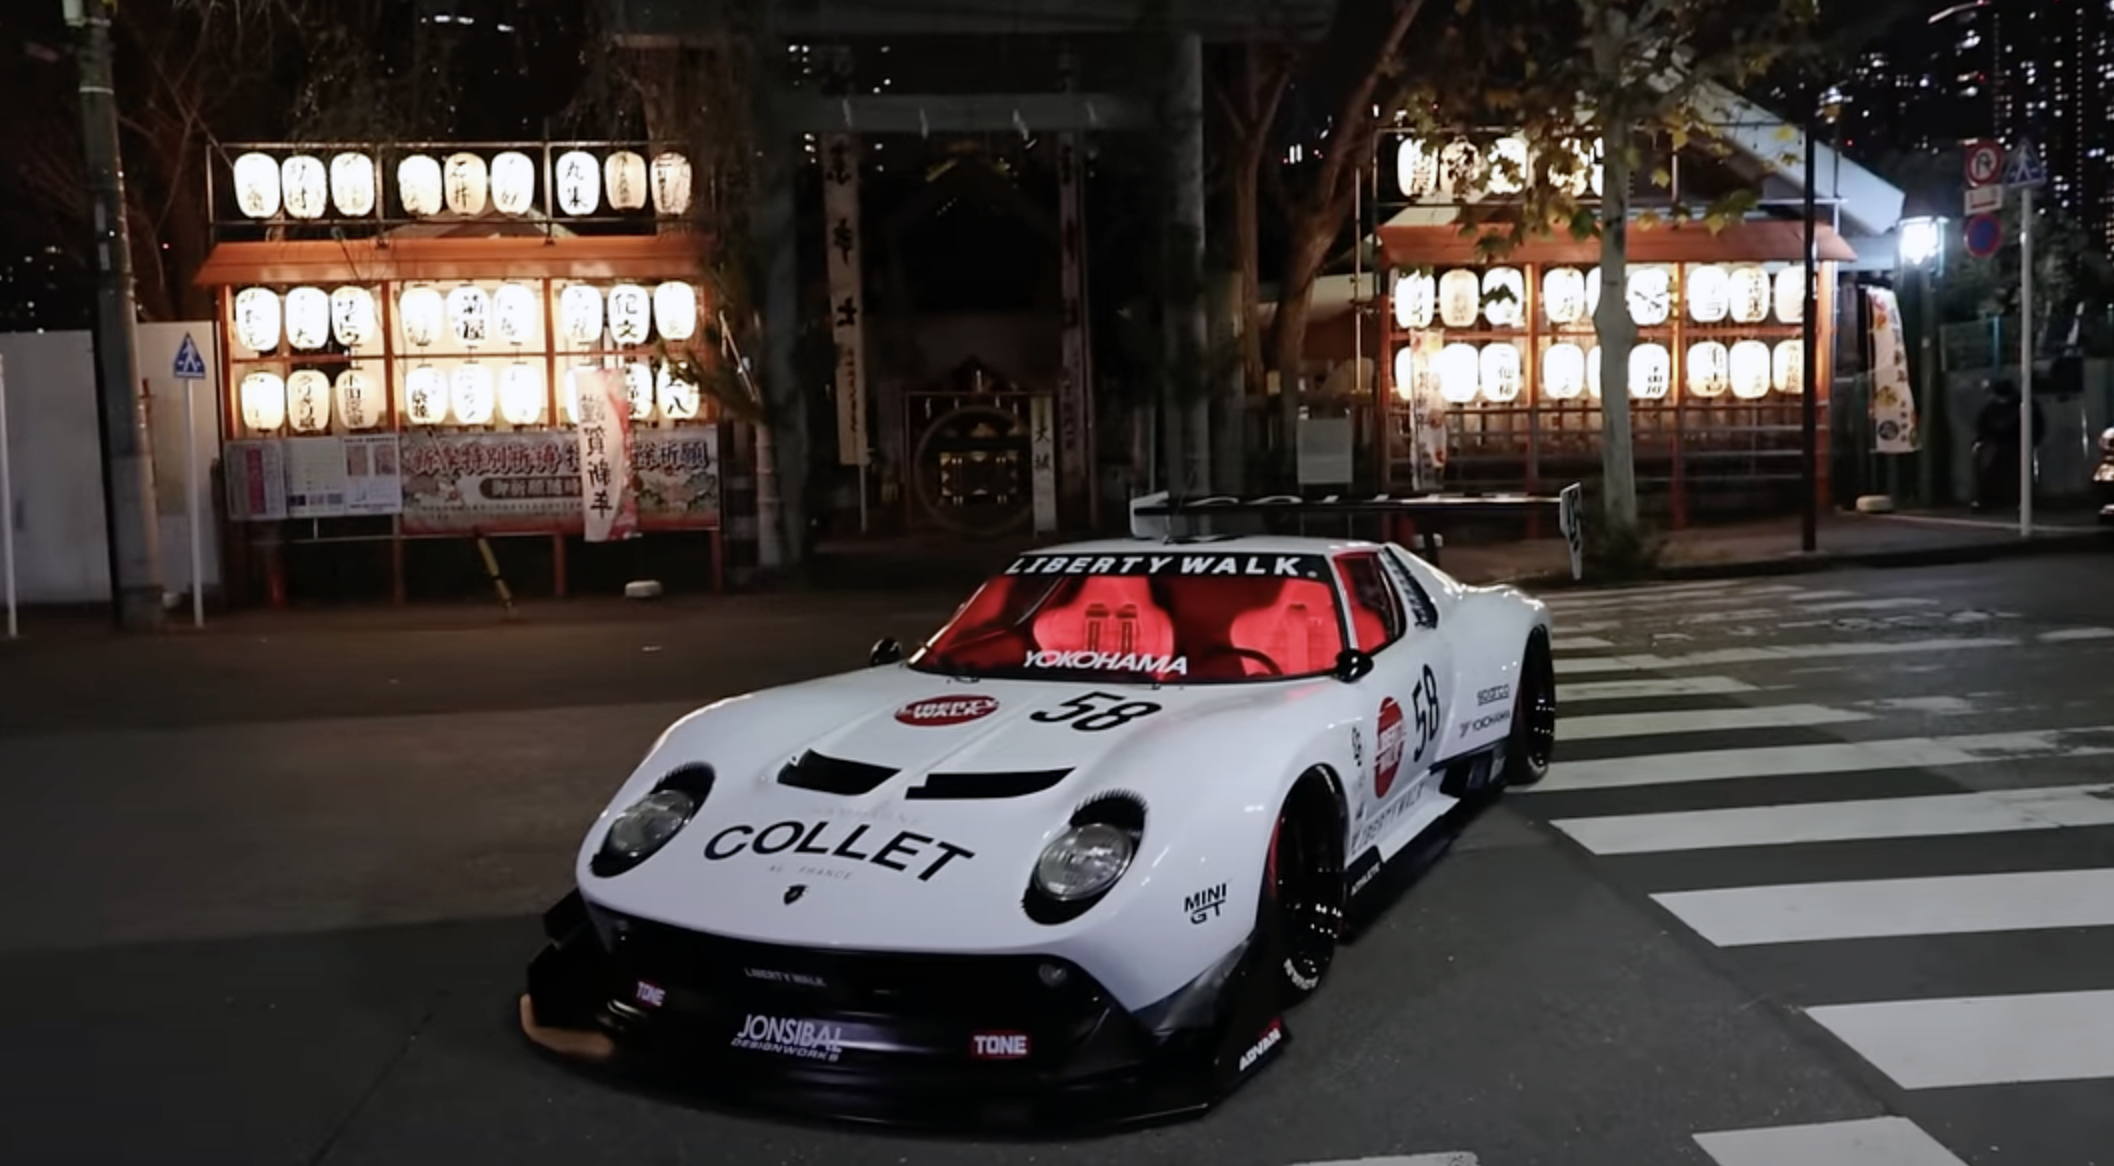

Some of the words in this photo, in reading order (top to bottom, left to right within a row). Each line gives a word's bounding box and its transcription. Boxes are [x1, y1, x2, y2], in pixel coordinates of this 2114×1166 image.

[615, 292, 639, 338] 紀文
[1004, 557, 1172, 575] LIBERTY
[1180, 557, 1301, 576] WALK
[1023, 650, 1188, 675] YOKOHAMA
[1030, 691, 1162, 731] 58
[1412, 664, 1440, 762] 58
[704, 820, 976, 882] COLLET
[799, 865, 854, 881] FRANCE
[1184, 883, 1227, 913] MINI
[1190, 899, 1226, 925] GT
[636, 981, 666, 1007] TONE
[737, 1013, 843, 1053] JONSIBAL
[973, 1034, 1028, 1056] TONE
[731, 1037, 840, 1062] DESIGNWORKS
[1239, 1028, 1282, 1071] ADVAN
